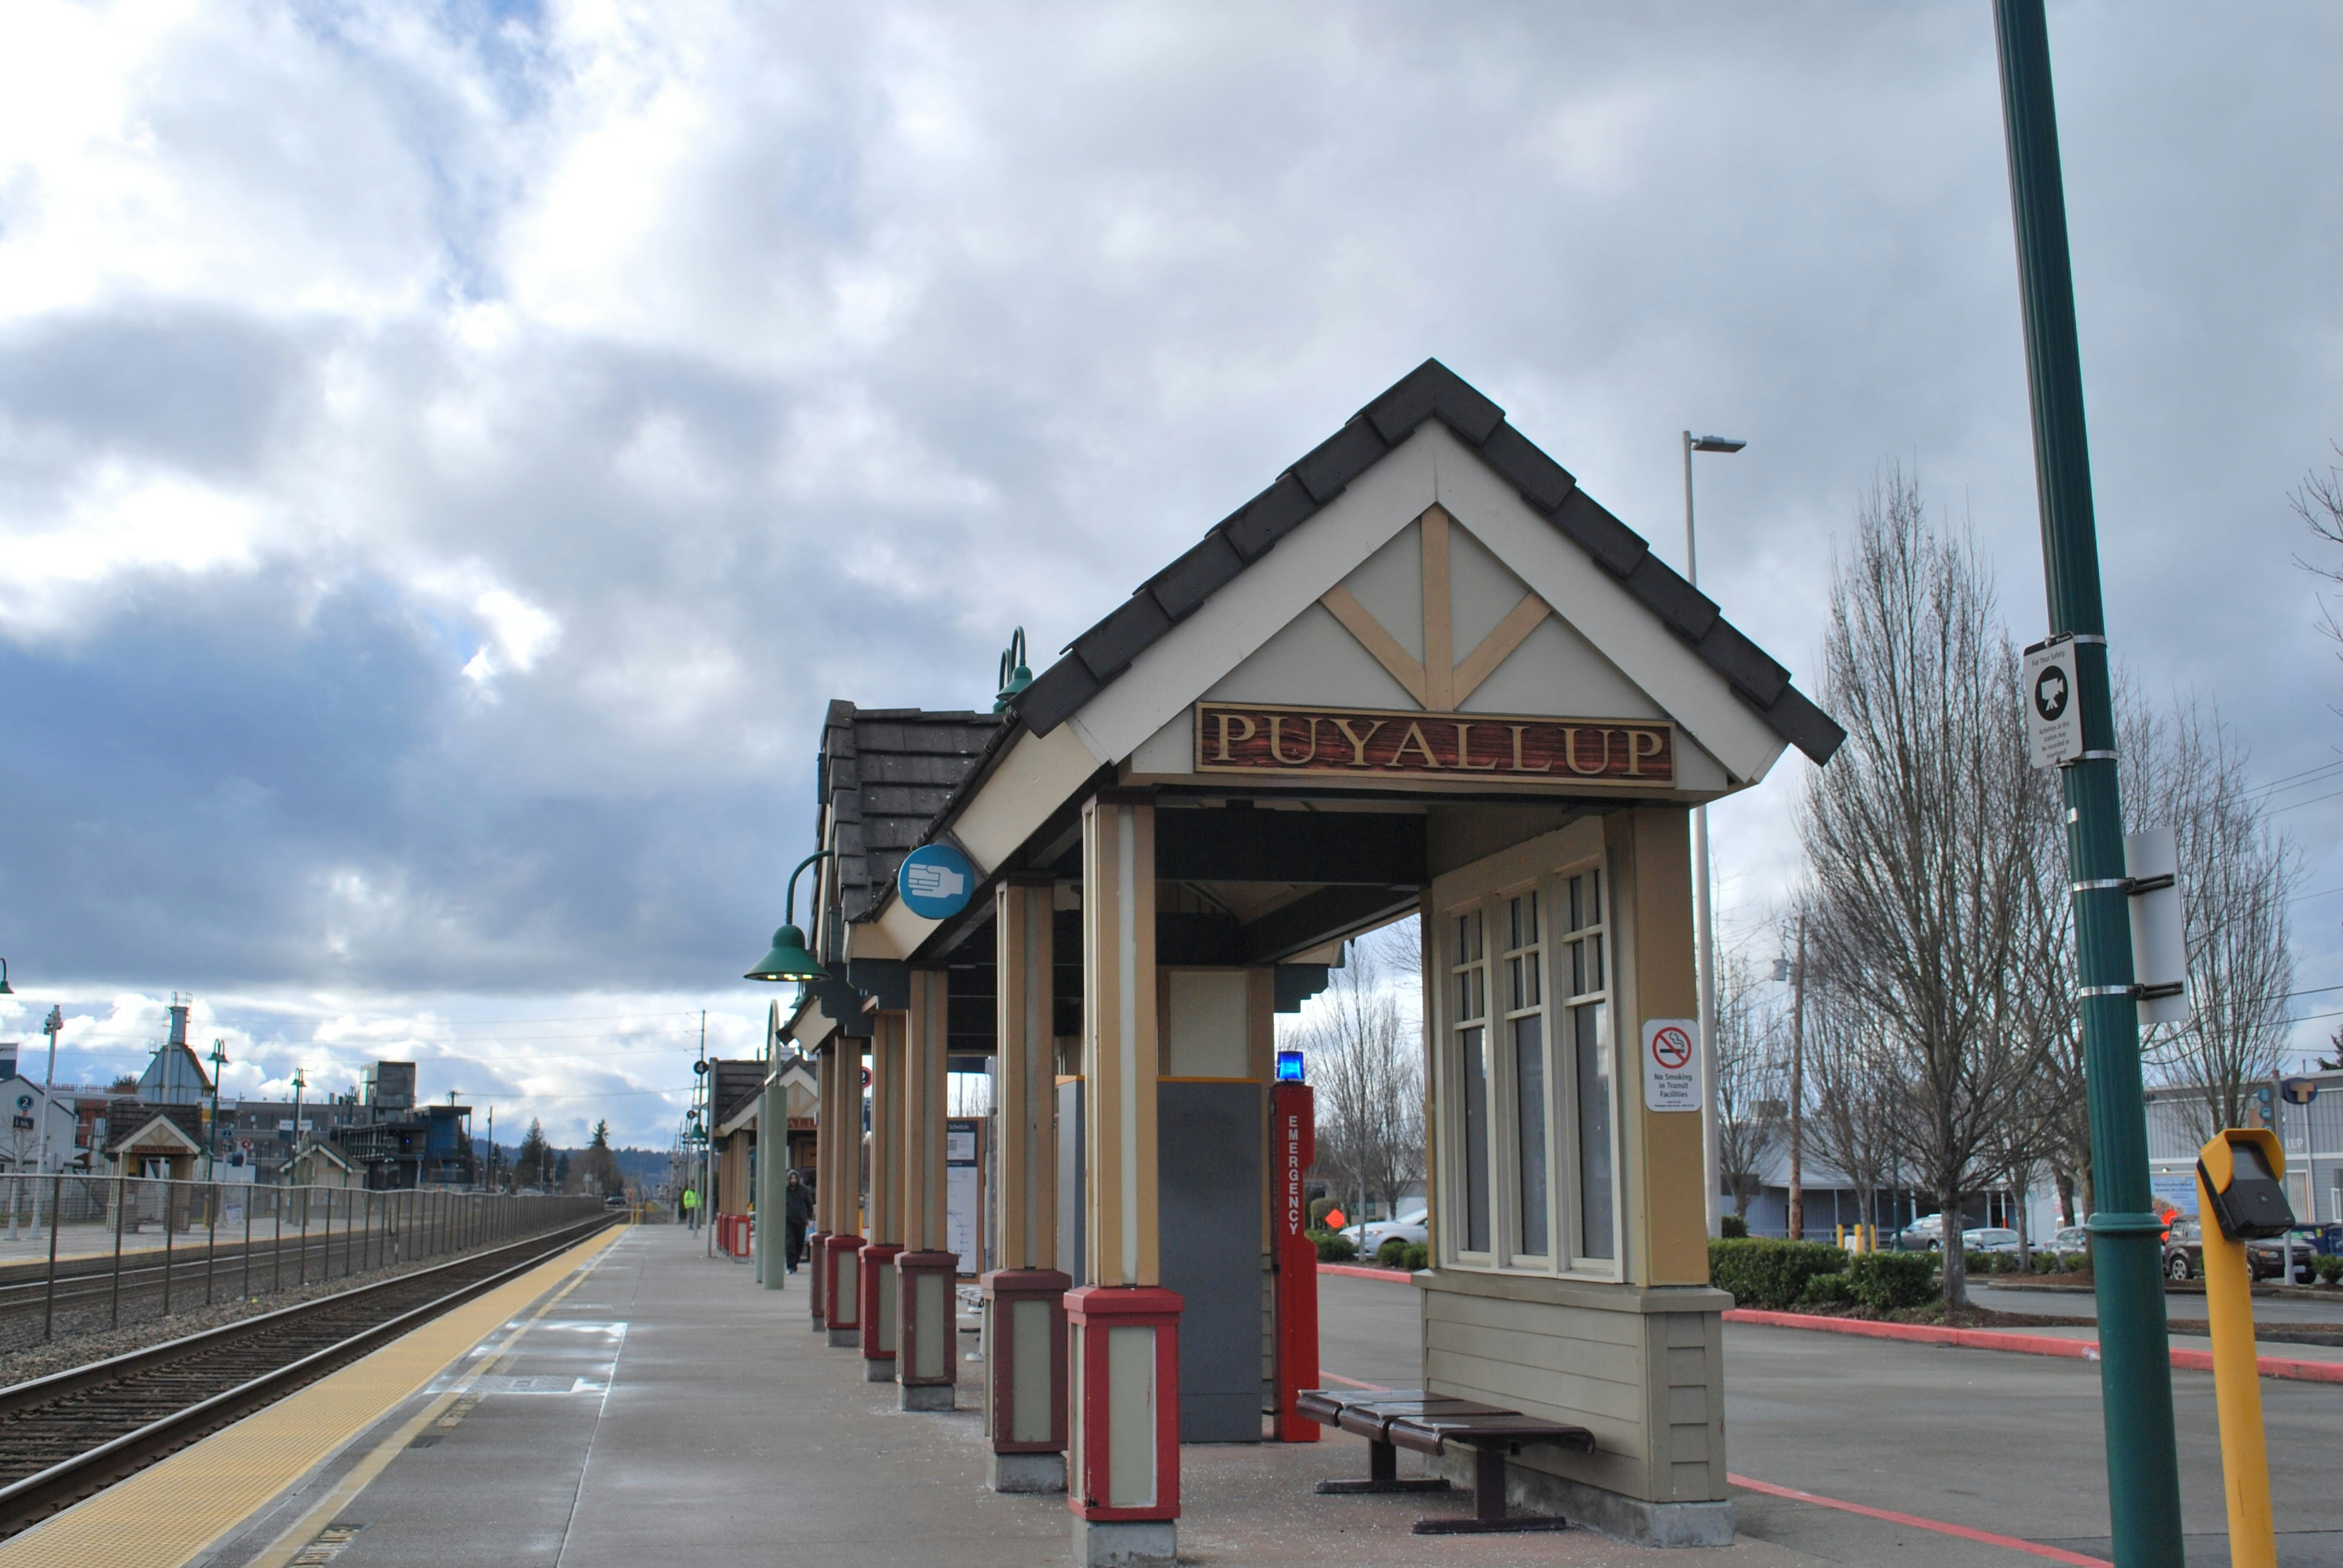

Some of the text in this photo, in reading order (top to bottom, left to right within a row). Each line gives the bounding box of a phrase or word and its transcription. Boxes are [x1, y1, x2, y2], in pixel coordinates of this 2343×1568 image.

[2040, 655, 2050, 664] Your
[2039, 726, 2056, 734] Activities
[1212, 714, 1663, 775] PUYALLUP
[2048, 740, 2064, 750] recorded
[696, 1063, 703, 1071] 4
[1665, 1073, 1693, 1082] Smoking
[21, 1097, 29, 1107] 2
[1288, 1116, 1299, 1235] EMERGENCY
